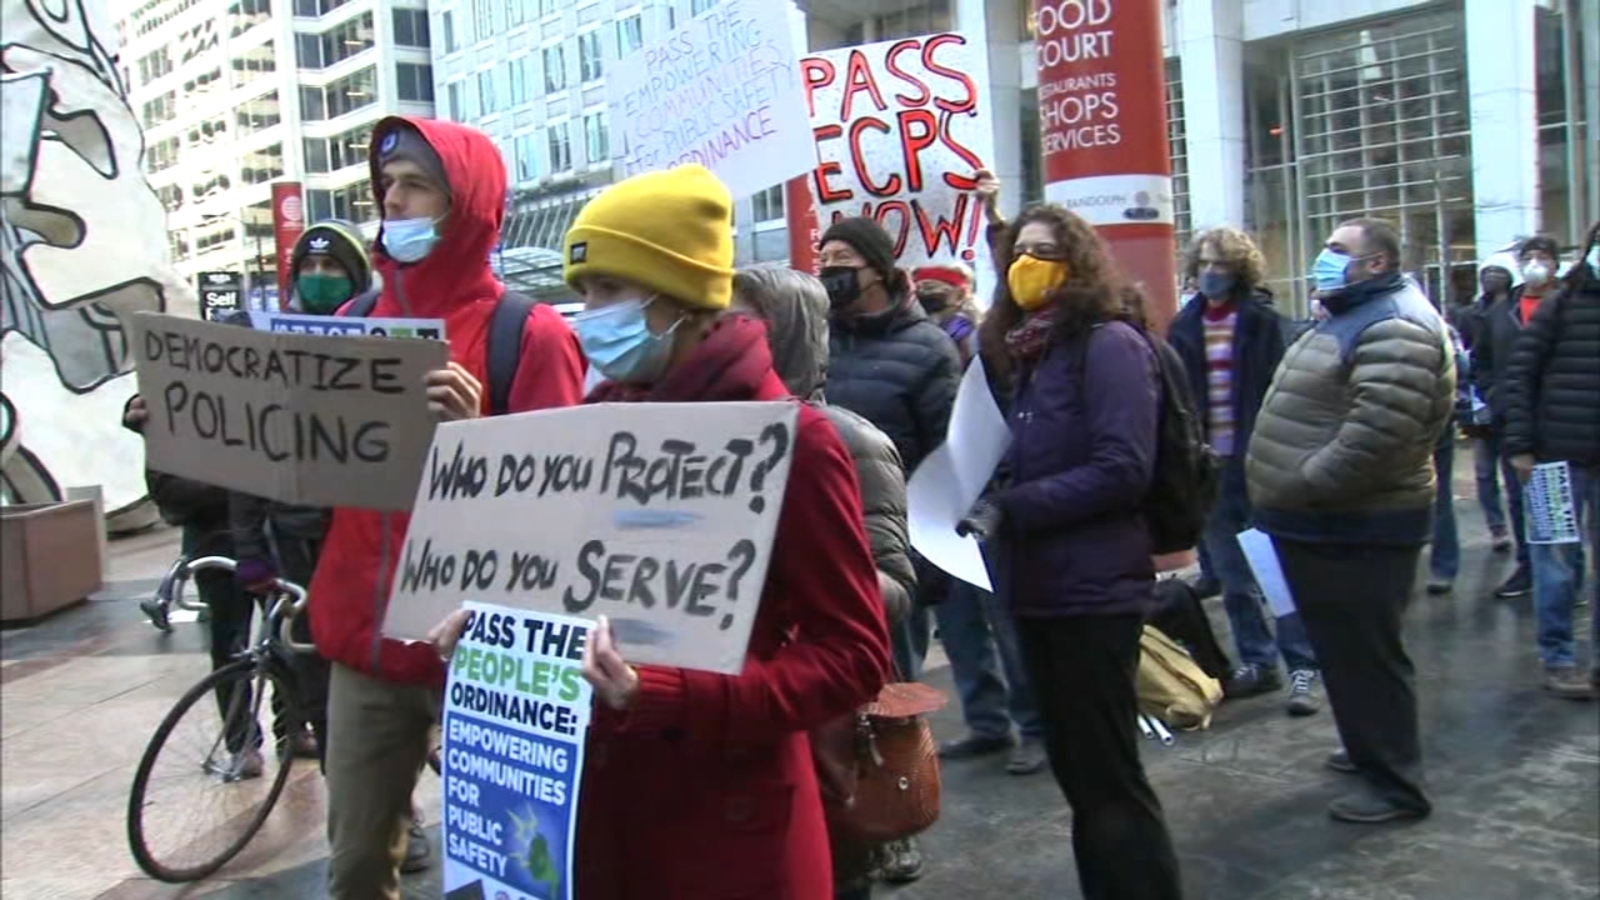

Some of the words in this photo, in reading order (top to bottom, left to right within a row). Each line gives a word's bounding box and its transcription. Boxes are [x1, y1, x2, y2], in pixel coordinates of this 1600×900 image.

[644, 29, 695, 76] PASS
[704, 0, 742, 41] THE
[800, 34, 977, 122] PASS
[667, 104, 777, 171] DINANCE
[812, 108, 984, 205] ECPS
[832, 194, 984, 261] OW!
[144, 329, 405, 394] DEMOCRATIZE
[164, 381, 392, 463] POLICING
[494, 453, 535, 497] DO
[538, 454, 594, 497] YOU
[601, 422, 789, 515] PROTECT?
[460, 549, 498, 593] DO
[505, 550, 560, 593] YOU
[562, 538, 757, 632] SERVE?
[459, 610, 516, 650] PASS
[524, 618, 589, 661] THE
[453, 645, 582, 702] PEOPLE'S
[450, 681, 578, 736] ORDINANCE:
[448, 747, 567, 806] COMMUNITIES
[449, 717, 569, 774] EMPOWERING
[448, 775, 481, 807] FOR
[448, 804, 503, 846] PUBLIC
[448, 833, 509, 878] SAFETY
